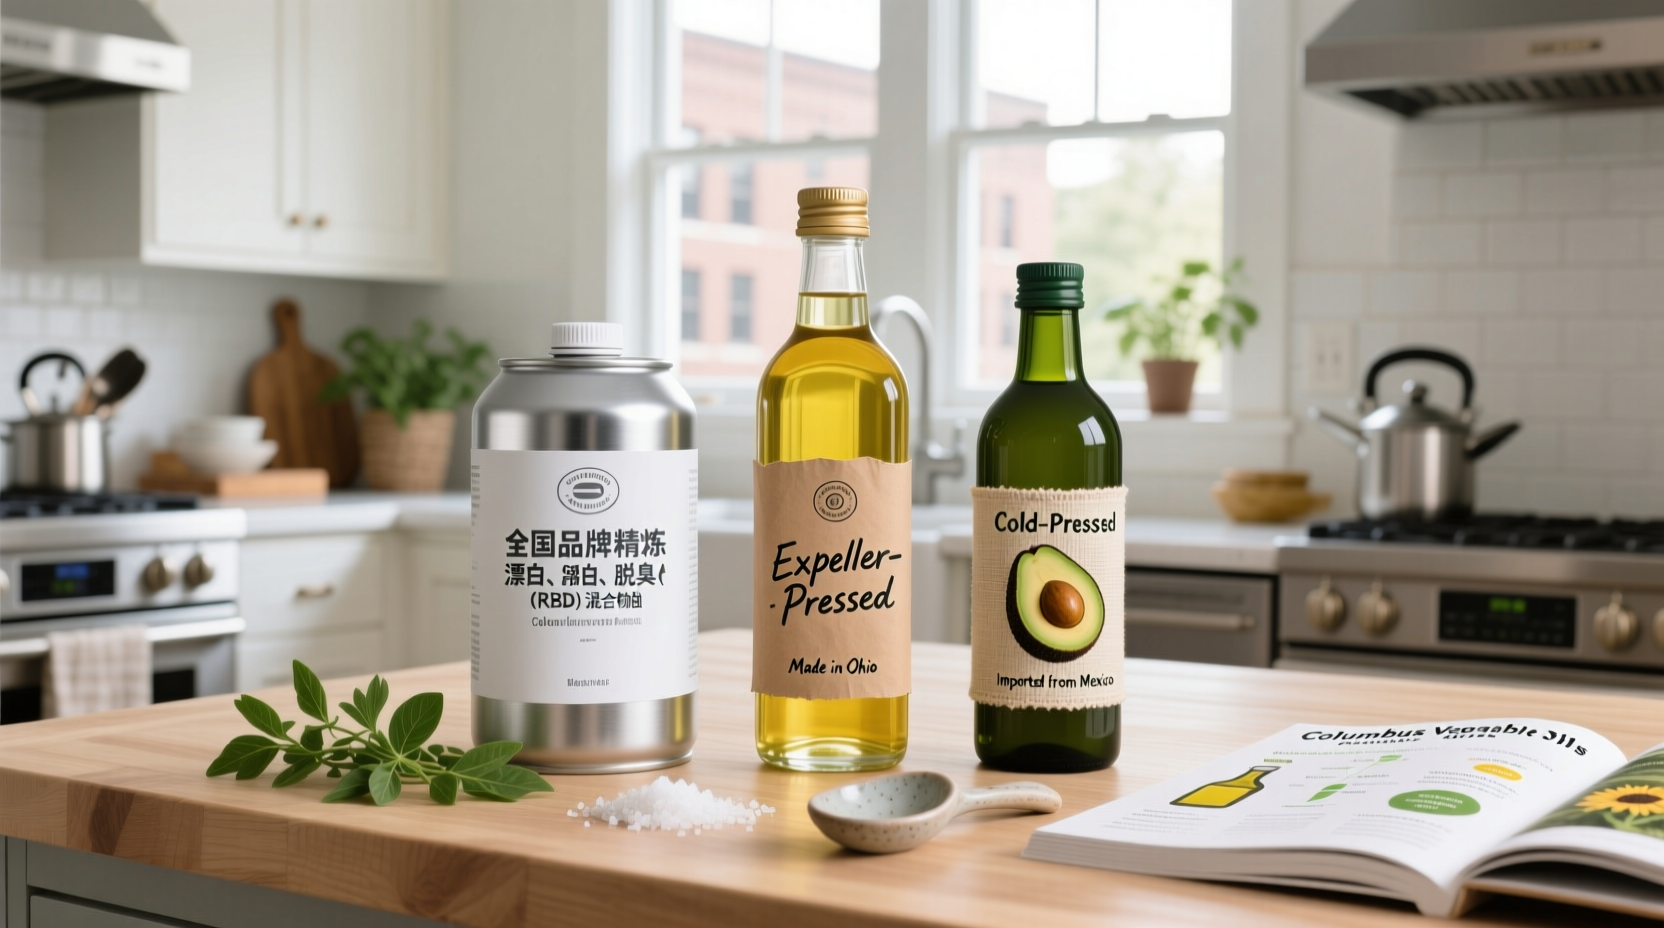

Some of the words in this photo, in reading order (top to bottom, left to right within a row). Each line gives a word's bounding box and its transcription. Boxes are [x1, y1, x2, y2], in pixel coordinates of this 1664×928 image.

[995, 511, 1116, 533] Cold-Pressed
[506, 528, 666, 558] 全国品牌精炼
[772, 537, 902, 587] Expeller-
[530, 592, 581, 610] (RBD)
[788, 657, 827, 674] Made
[830, 659, 843, 674] in
[846, 657, 878, 674] Ohio
[1048, 674, 1077, 689] from
[1301, 728, 1426, 742] Columbus
